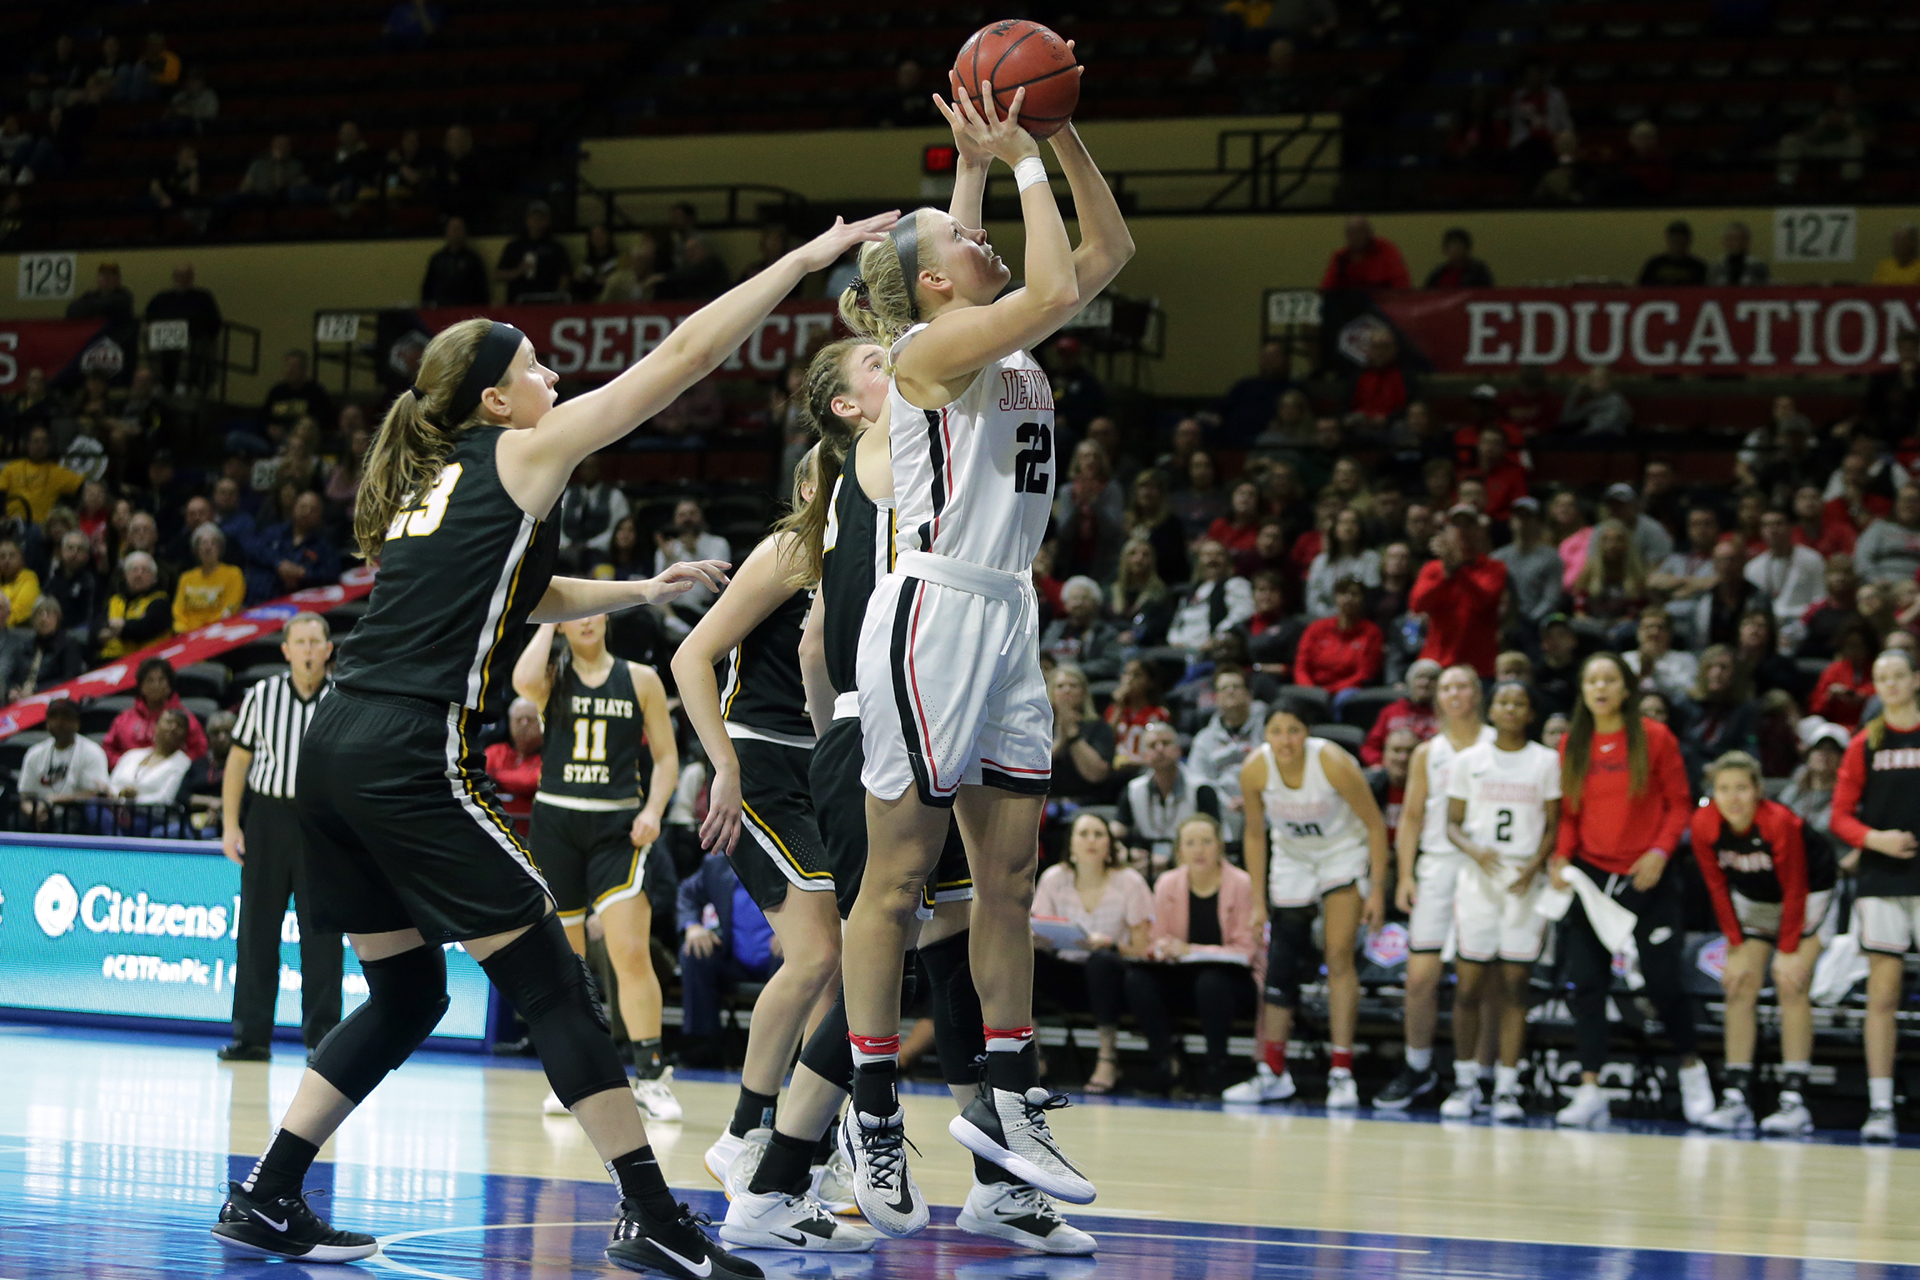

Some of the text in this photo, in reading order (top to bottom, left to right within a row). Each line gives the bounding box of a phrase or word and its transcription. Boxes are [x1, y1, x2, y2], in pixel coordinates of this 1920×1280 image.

[1780, 213, 1850, 257] 127
[24, 258, 72, 295] 129
[572, 695, 634, 719] RT HAYS
[572, 717, 608, 762] 11
[563, 763, 610, 784] STATE
[1496, 809, 1513, 842] 2
[80, 884, 228, 940] Citizens
